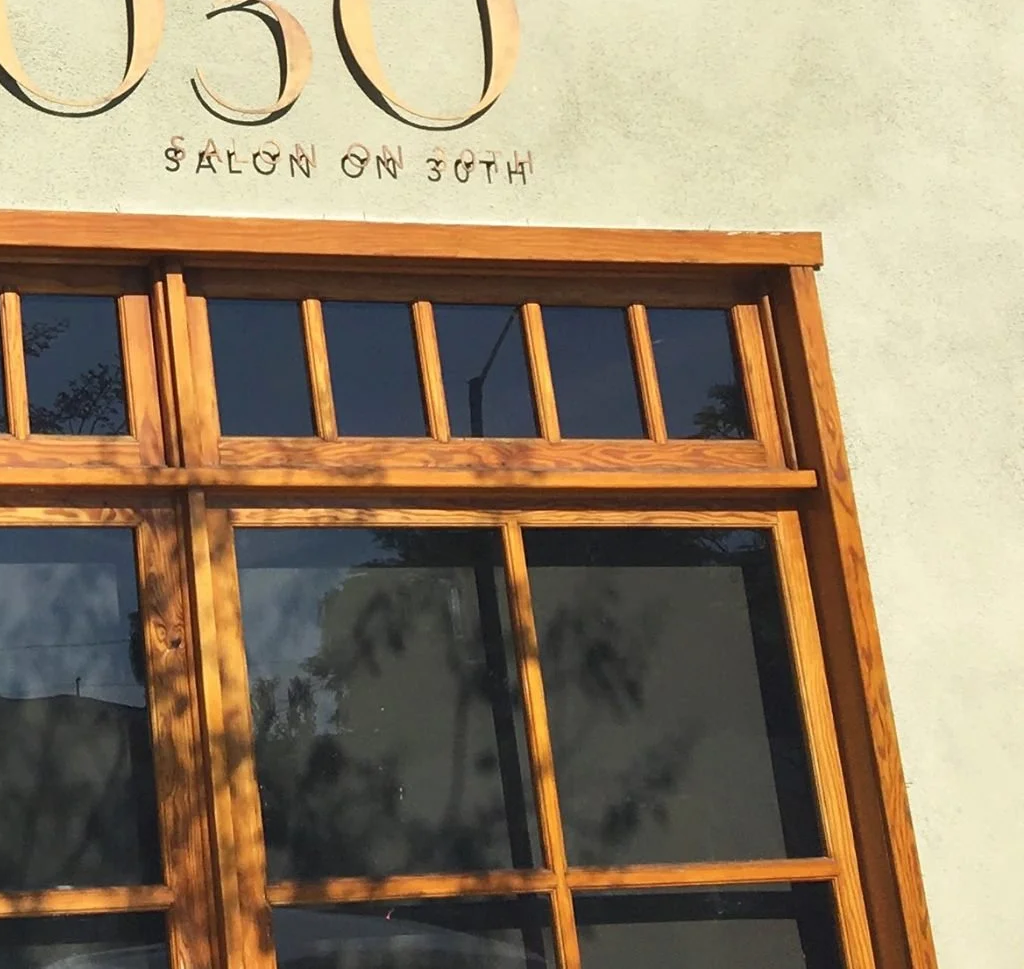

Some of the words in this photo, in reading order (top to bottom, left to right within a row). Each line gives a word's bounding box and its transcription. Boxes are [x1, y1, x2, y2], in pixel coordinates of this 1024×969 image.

[164, 135, 316, 179] SALON
[341, 142, 404, 181] ON
[426, 147, 534, 186] 30TH
